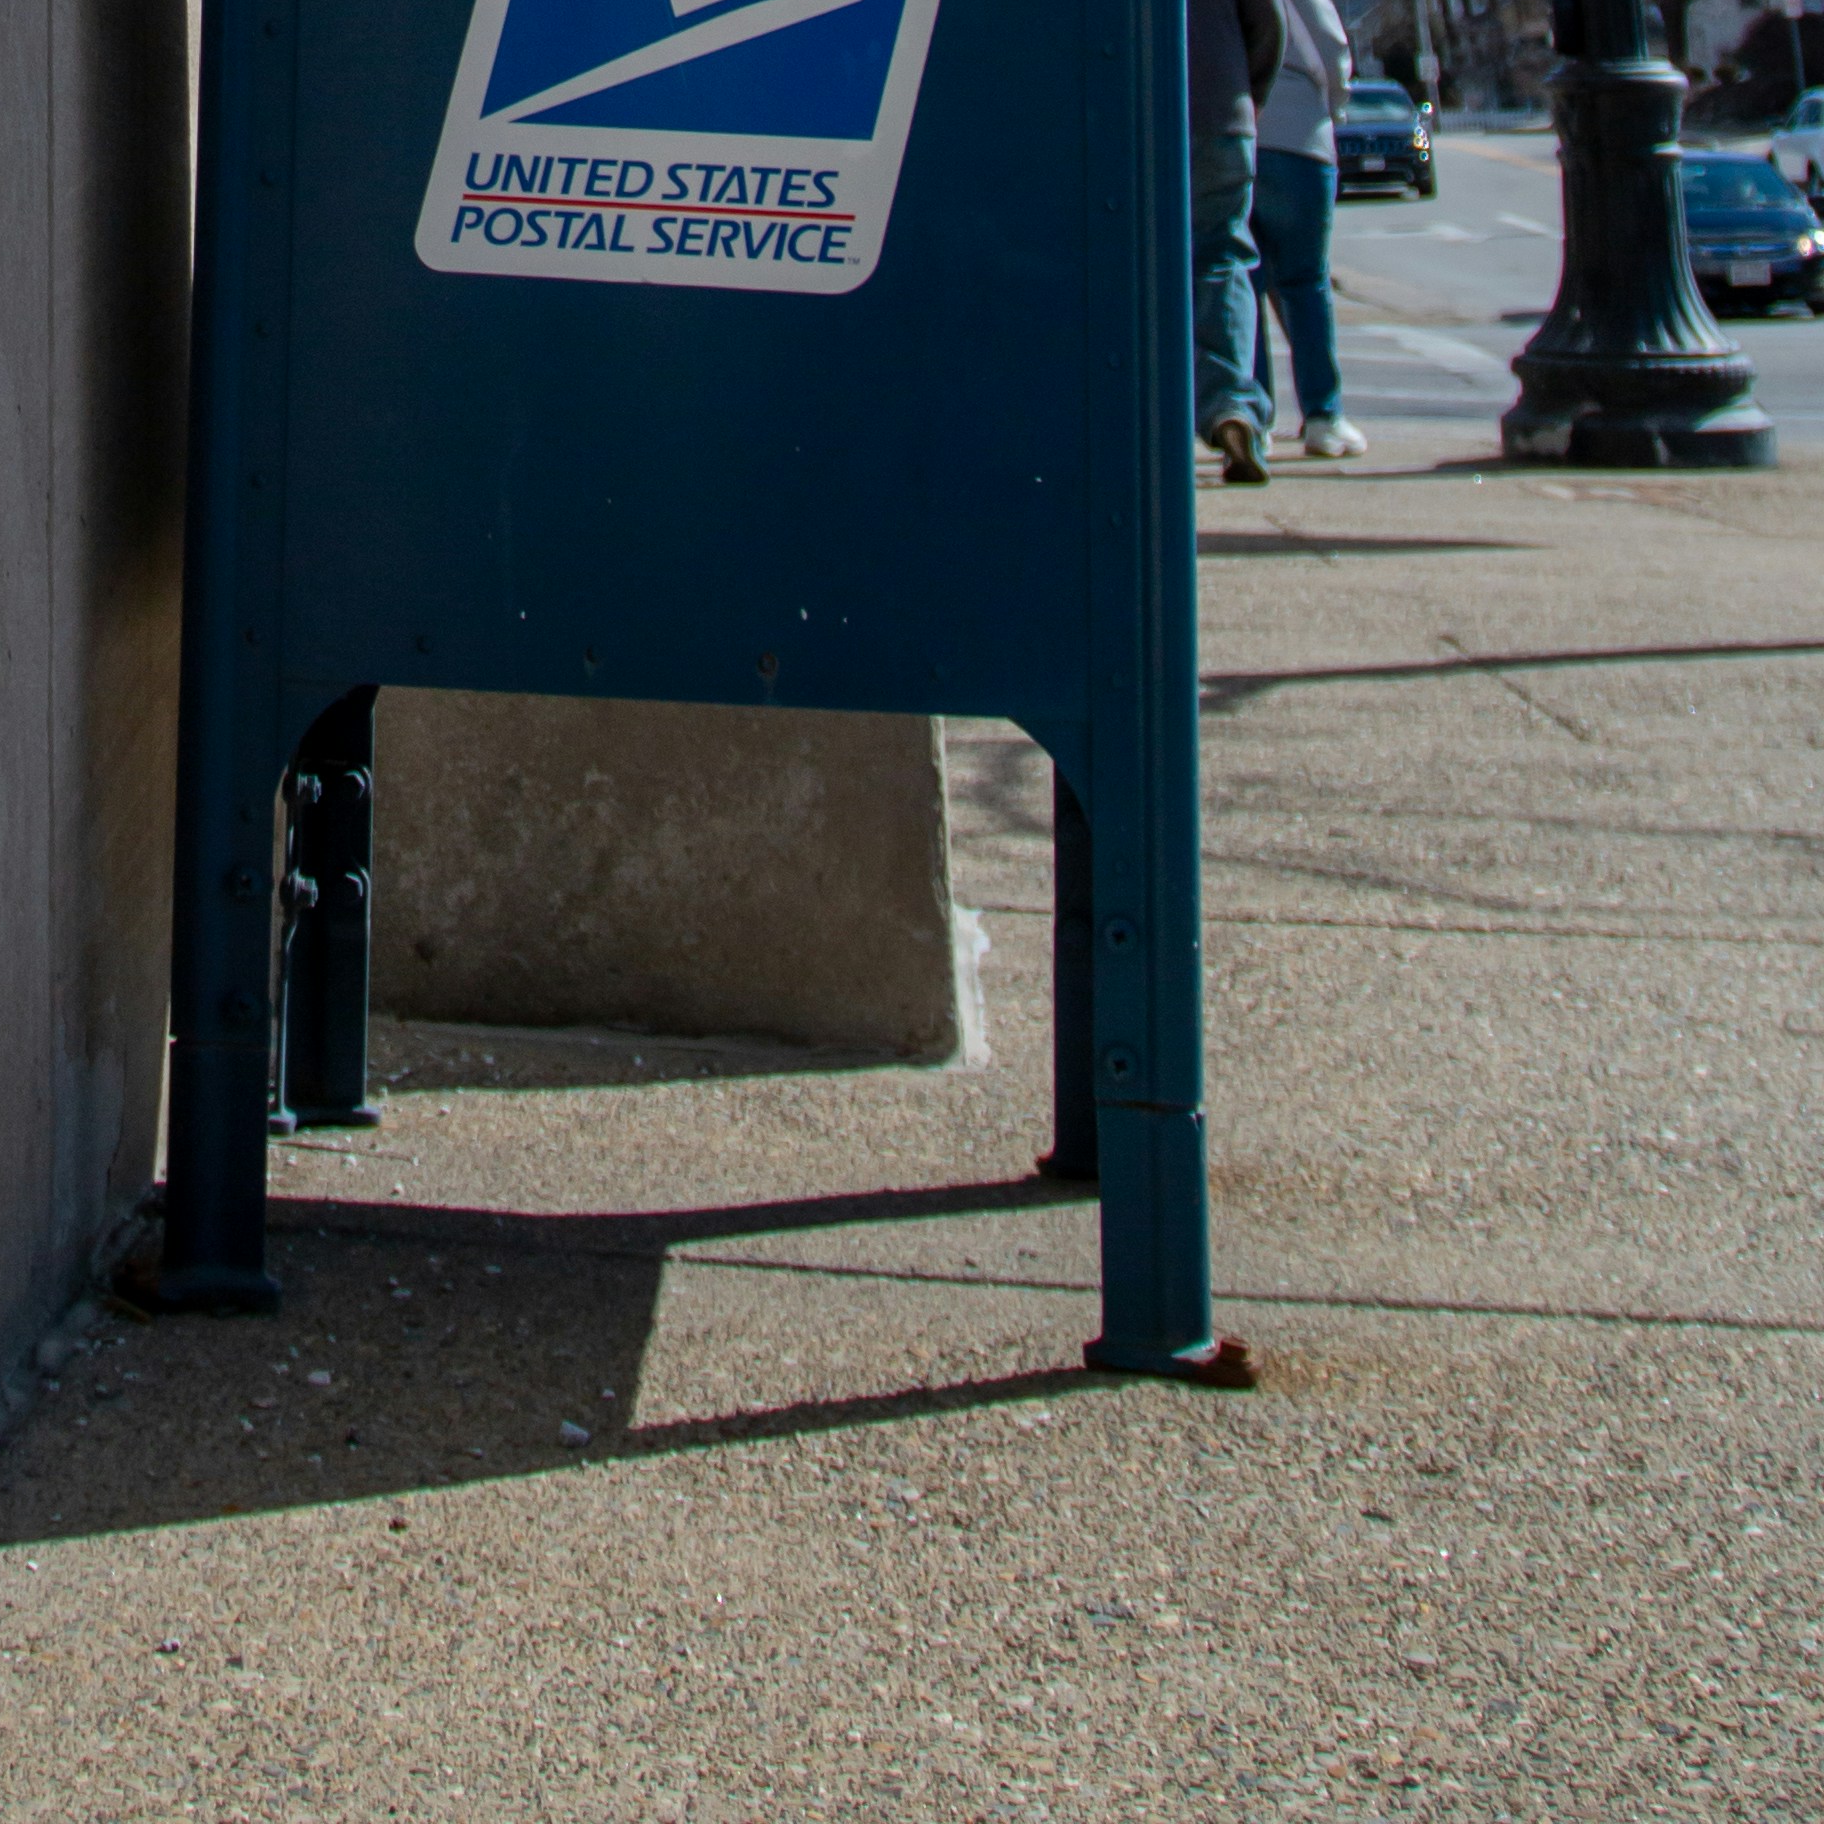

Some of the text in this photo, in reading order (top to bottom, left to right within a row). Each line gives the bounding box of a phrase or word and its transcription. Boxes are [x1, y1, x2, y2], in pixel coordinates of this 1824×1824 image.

[465, 152, 840, 209] UNITED STATES
[450, 205, 635, 253] POSTAL
[646, 216, 853, 265] SERVICE
